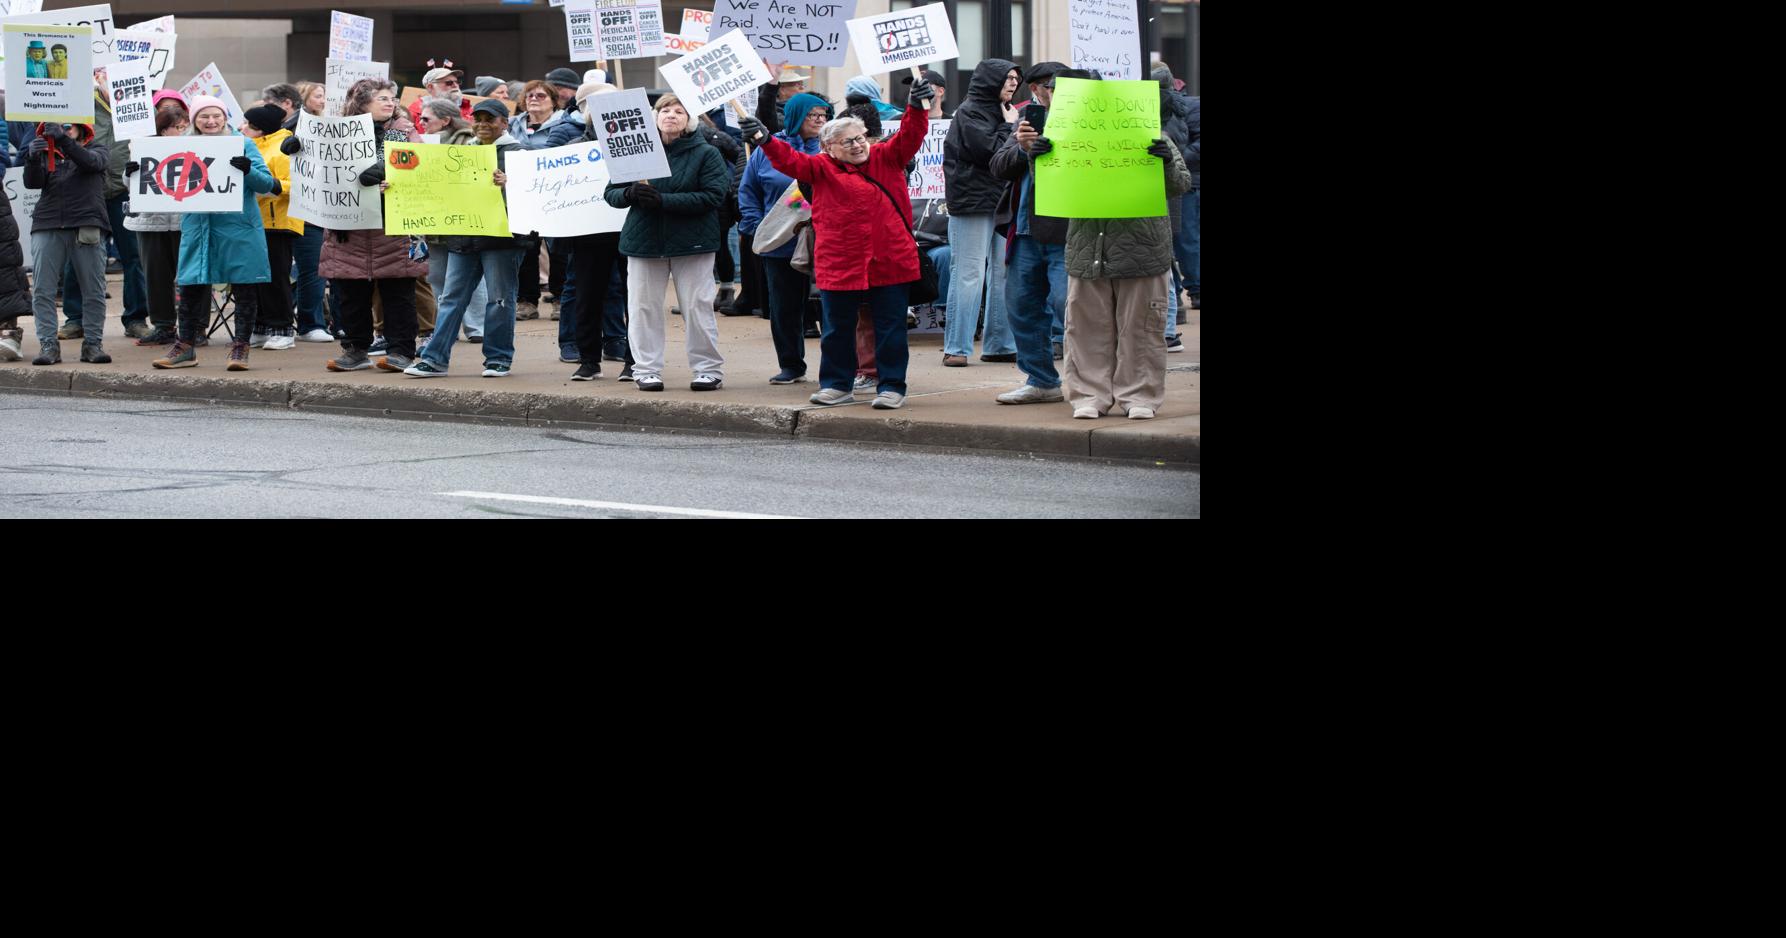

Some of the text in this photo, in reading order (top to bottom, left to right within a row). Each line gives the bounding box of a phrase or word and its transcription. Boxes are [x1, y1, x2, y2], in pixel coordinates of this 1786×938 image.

[729, 0, 842, 17] We Are NOT
[602, 16, 632, 26] OFF!
[768, 18, 809, 29] We're
[875, 16, 925, 35] HANDS
[600, 26, 635, 35] MEDICAID
[573, 38, 592, 46] FAIR
[601, 35, 638, 43] MEDICARE
[880, 28, 930, 52] OFF!
[138, 41, 150, 53] FOR
[606, 43, 636, 52] SOCIAL
[607, 49, 637, 57] SECURITY
[682, 44, 732, 73] HANDS
[882, 46, 937, 64] IMMIGRANTS
[691, 53, 743, 89] OFF!
[112, 76, 145, 88] HANDS
[697, 70, 756, 106] MEDICARE
[114, 85, 146, 101] OFF!
[116, 102, 149, 115] POSTAL
[601, 108, 642, 121] HANDS
[117, 112, 149, 123] WORKERS
[605, 116, 646, 134] OFF!
[1072, 119, 1106, 130] YOUR
[1114, 117, 1159, 130] VOICE
[309, 120, 366, 139] GRANDPA
[607, 132, 653, 149] SOCIAL
[320, 140, 375, 161] FASCISTS
[389, 151, 415, 165] STOP
[609, 143, 654, 158] SECURITY
[537, 154, 581, 171] HANDS
[923, 154, 944, 166] HAN
[1100, 158, 1157, 168] SILENCE
[139, 157, 236, 195] RFK Jr
[294, 157, 357, 184] NOW IT'S
[526, 174, 601, 196] Higher
[302, 184, 360, 208] MY TURN
[403, 216, 437, 230] HANDS
